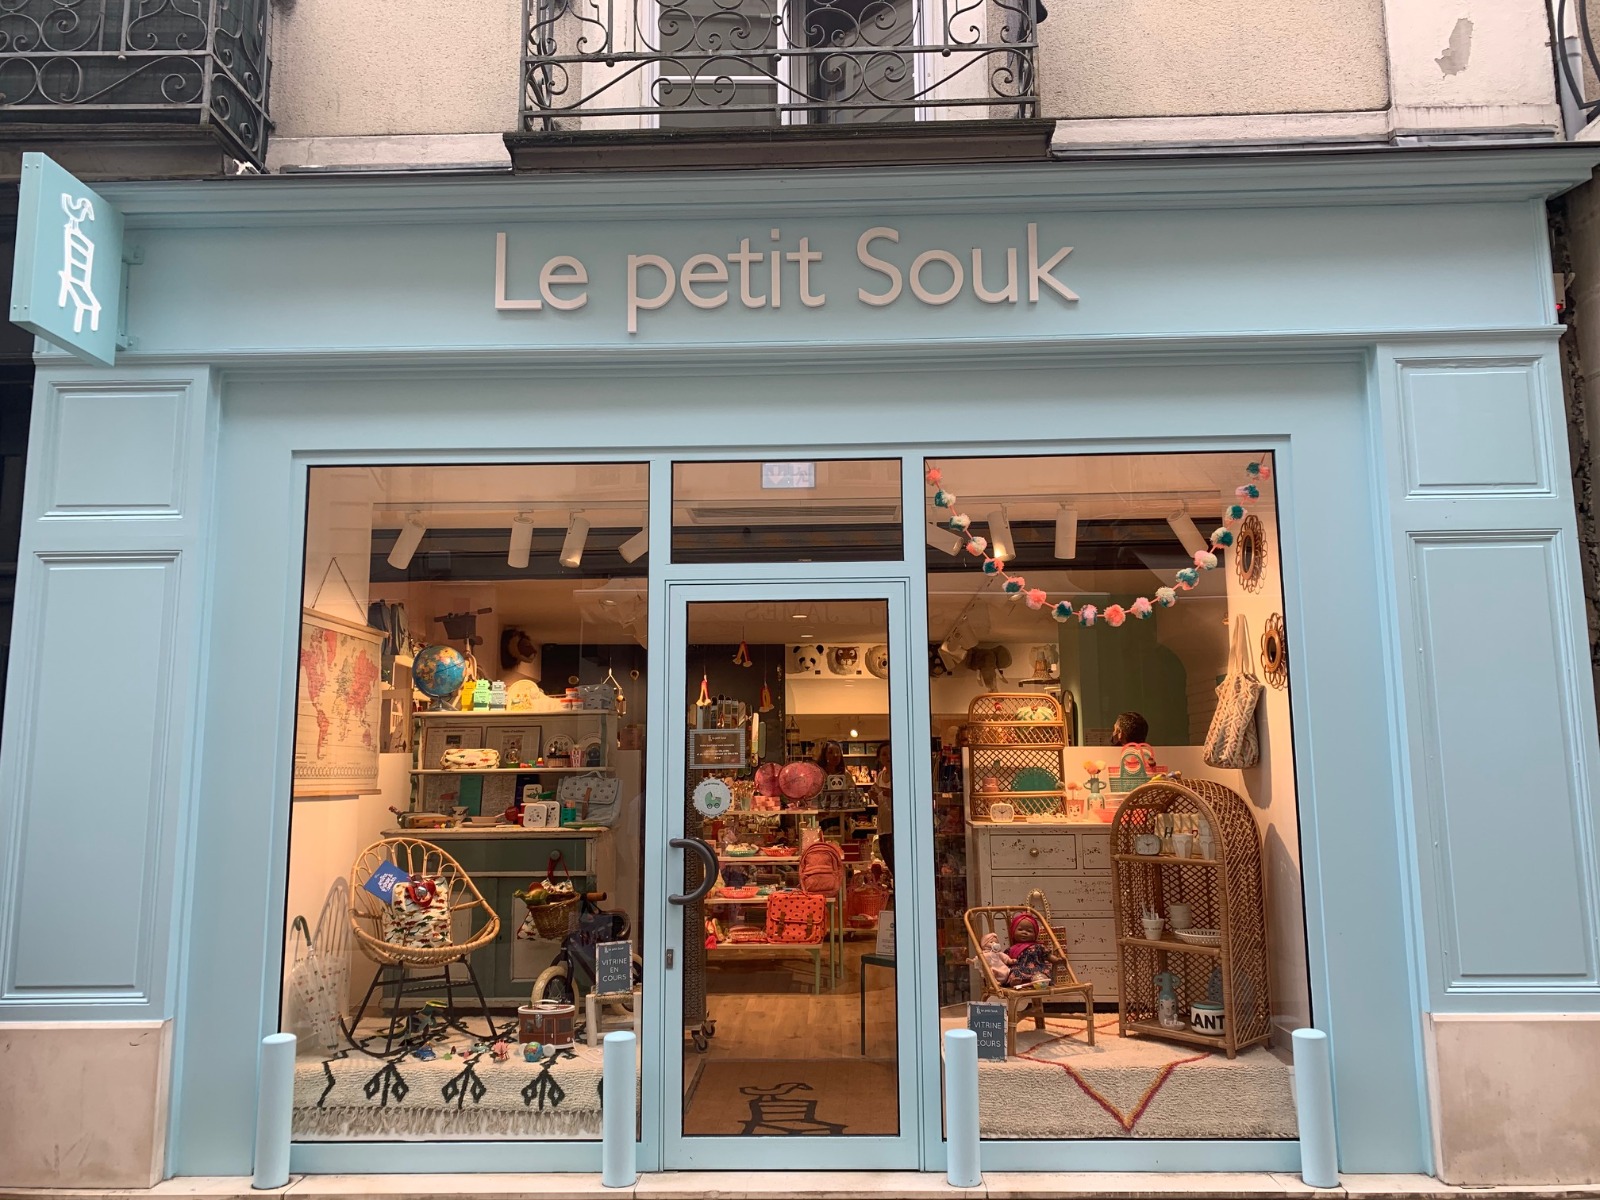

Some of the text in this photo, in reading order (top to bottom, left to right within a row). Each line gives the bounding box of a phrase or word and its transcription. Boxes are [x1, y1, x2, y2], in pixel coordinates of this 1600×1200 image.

[495, 222, 1080, 334] Le petit Souk
[602, 957, 627, 966] VITRINE
[602, 974, 627, 982] COURS
[974, 1021, 1002, 1030] VITRINE
[1191, 1012, 1226, 1030] ANT
